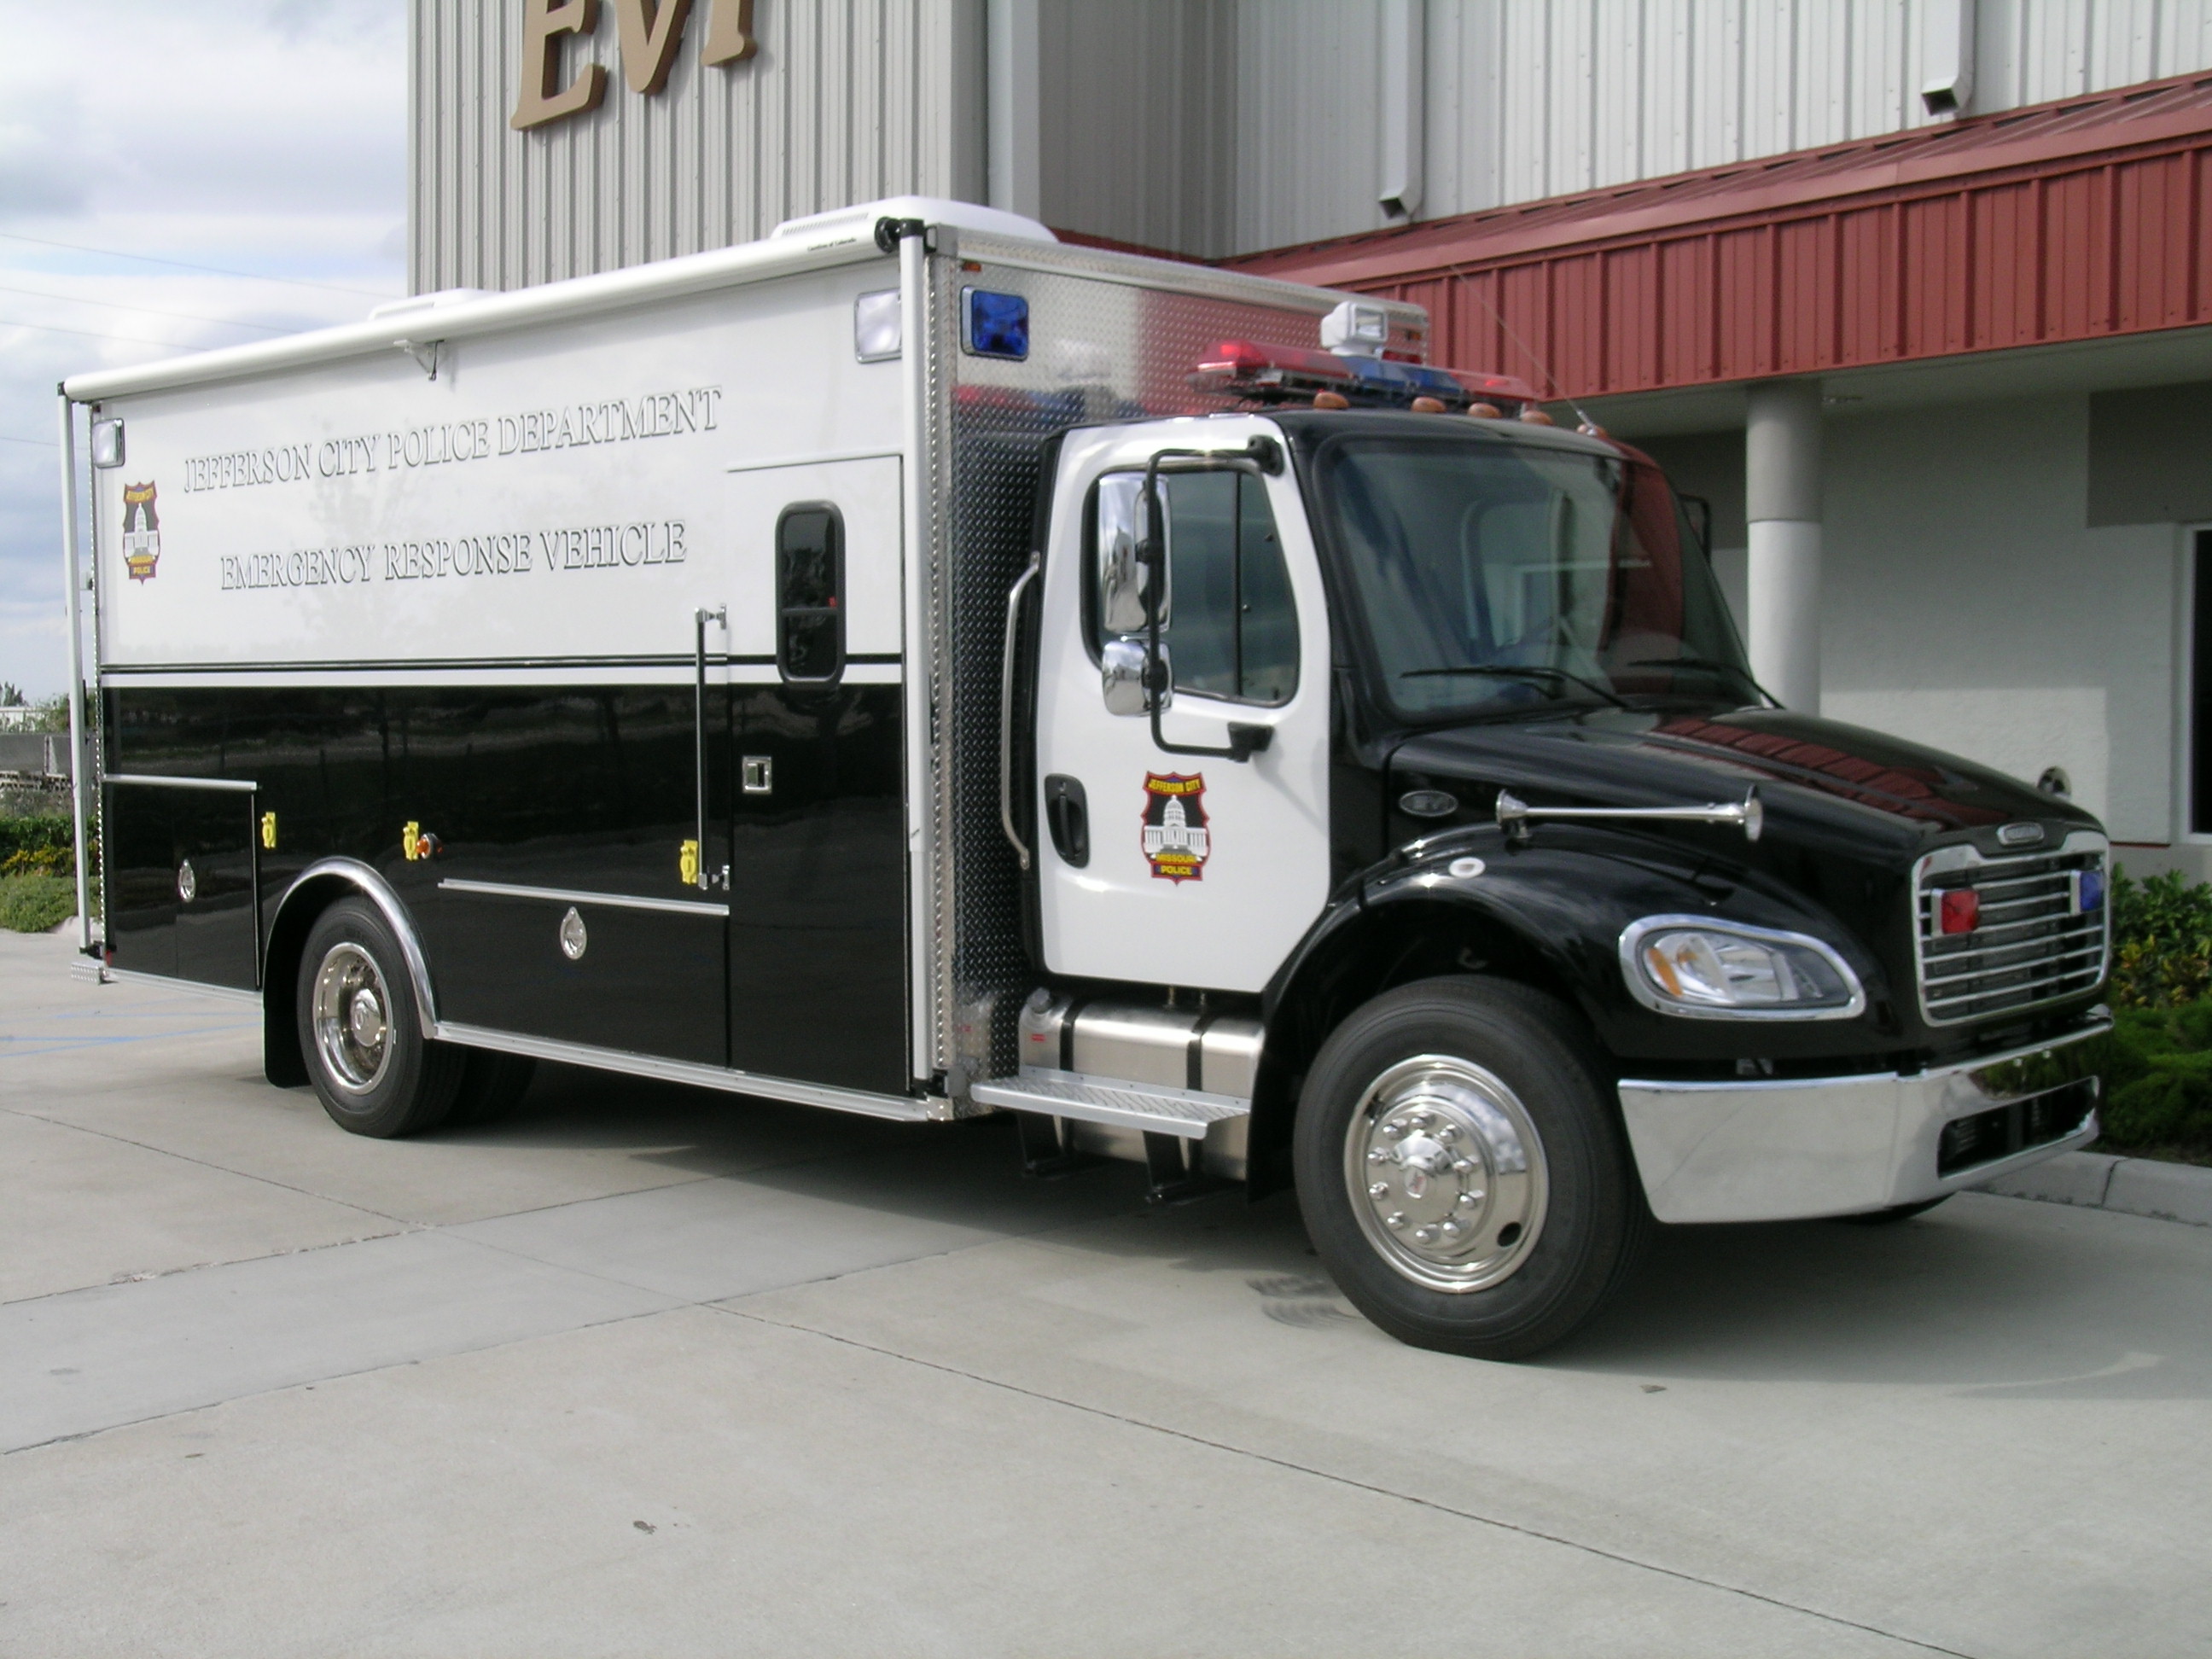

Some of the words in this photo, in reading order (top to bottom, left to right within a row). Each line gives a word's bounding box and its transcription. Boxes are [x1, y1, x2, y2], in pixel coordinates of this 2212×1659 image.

[183, 442, 312, 493] JEFFERSON
[318, 434, 381, 478] CITY
[387, 419, 492, 469] POLICE
[498, 385, 723, 456] DEPARTMENT
[220, 544, 375, 591] EMERGENCY
[384, 533, 533, 580] RESPONSE
[539, 520, 688, 572] VEHICLE
[1161, 864, 1193, 876] POLICE
